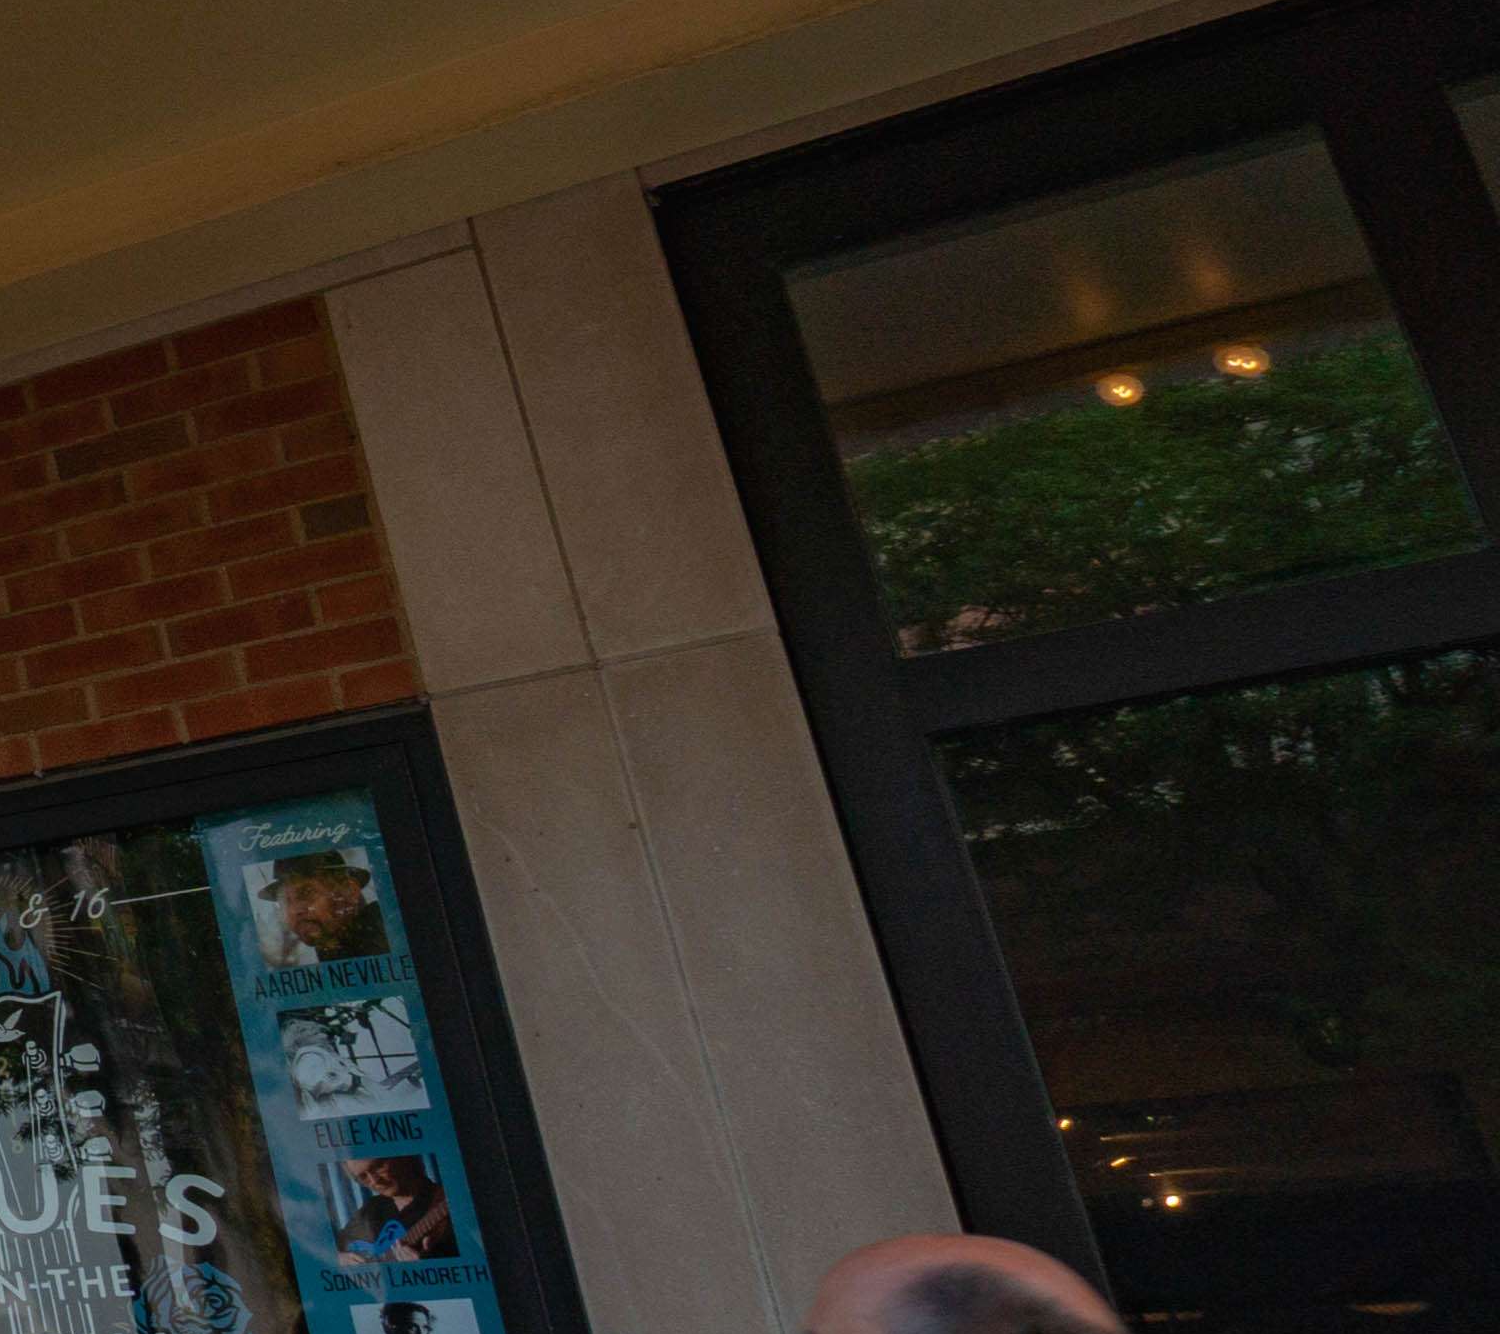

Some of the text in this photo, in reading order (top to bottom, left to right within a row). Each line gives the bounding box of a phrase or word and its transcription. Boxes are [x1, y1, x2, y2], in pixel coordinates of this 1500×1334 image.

[238, 821, 350, 852] Featuring
[20, 894, 50, 928] &
[68, 888, 109, 922] 16
[254, 954, 416, 1000] AARON NEVILLE
[314, 1113, 424, 1149] ELLE KING
[43, 1264, 135, 1301] THE
